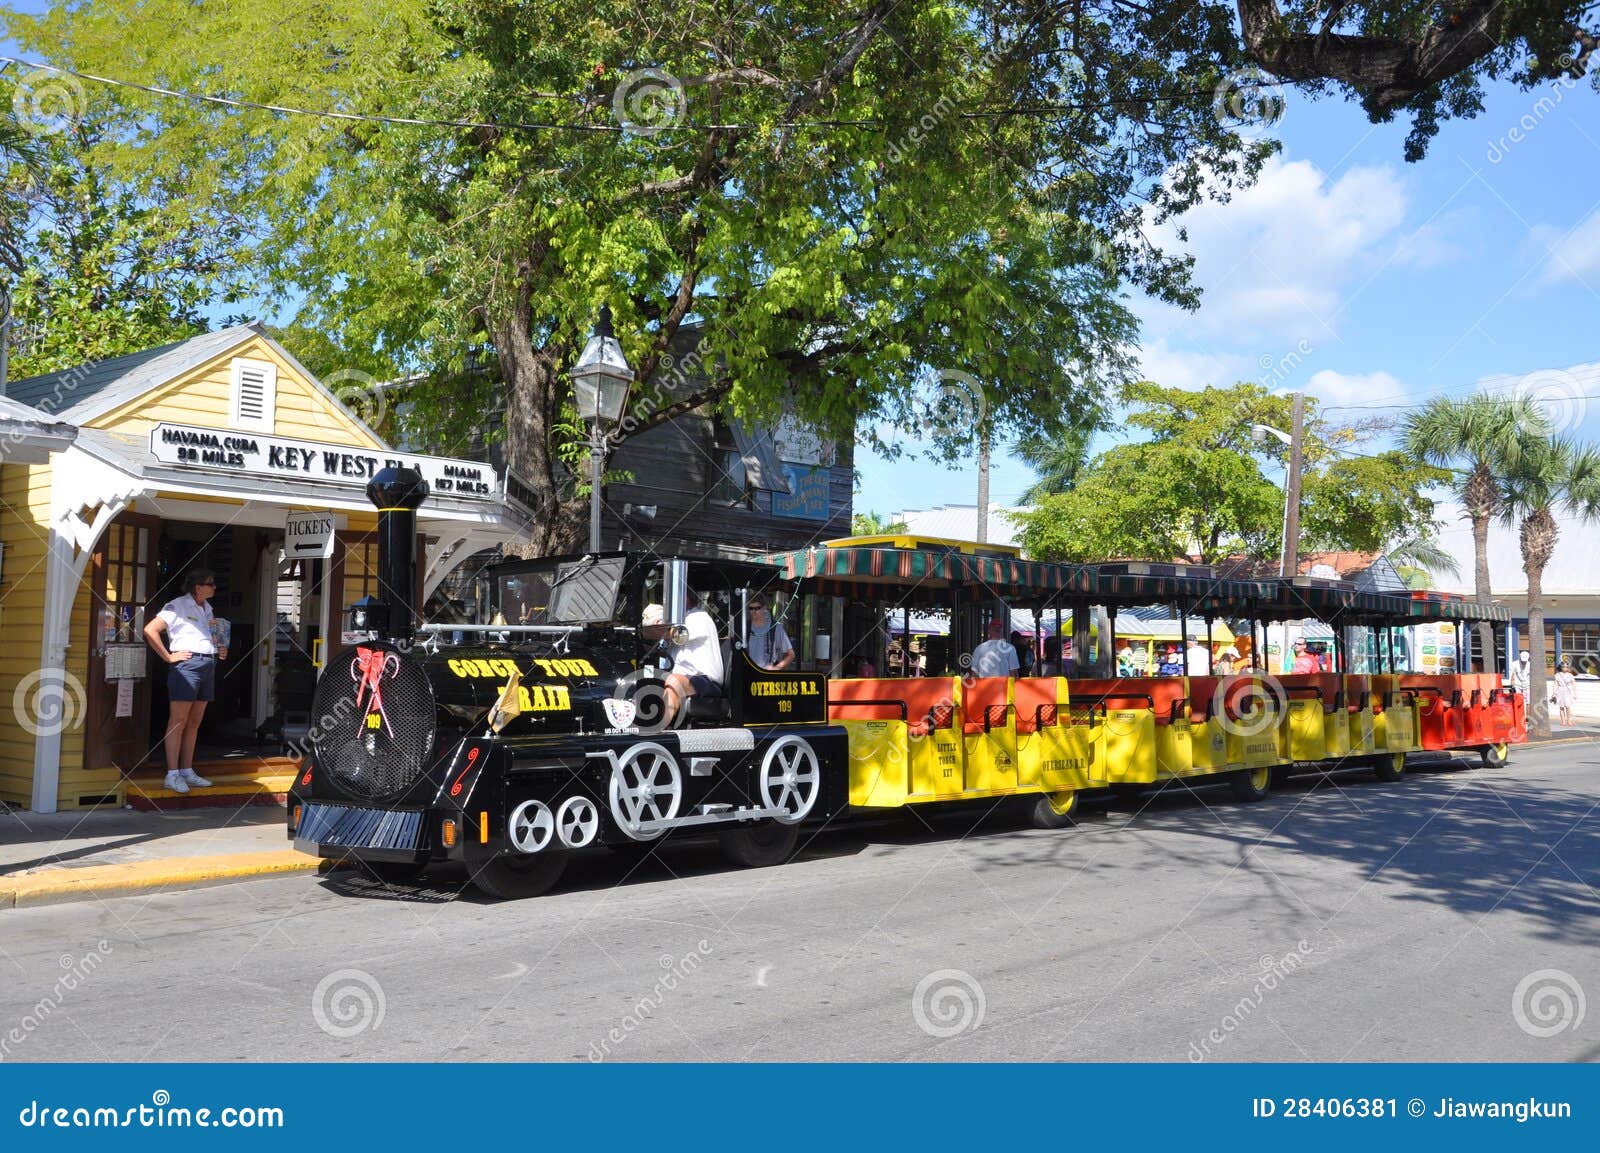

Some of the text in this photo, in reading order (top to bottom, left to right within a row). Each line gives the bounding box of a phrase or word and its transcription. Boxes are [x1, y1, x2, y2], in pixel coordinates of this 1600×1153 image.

[202, 450, 244, 466] MILES
[268, 445, 316, 472] KEY
[323, 451, 379, 479] WEST
[444, 464, 481, 480] MIAMI
[456, 480, 489, 494] MILES
[287, 518, 332, 536] TICKETS
[447, 658, 599, 678] CONCH TOUR
[750, 680, 820, 697] OVERSEAS R.R.
[497, 685, 571, 712] RAIN
[777, 700, 792, 713] 109
[366, 714, 381, 729] 109
